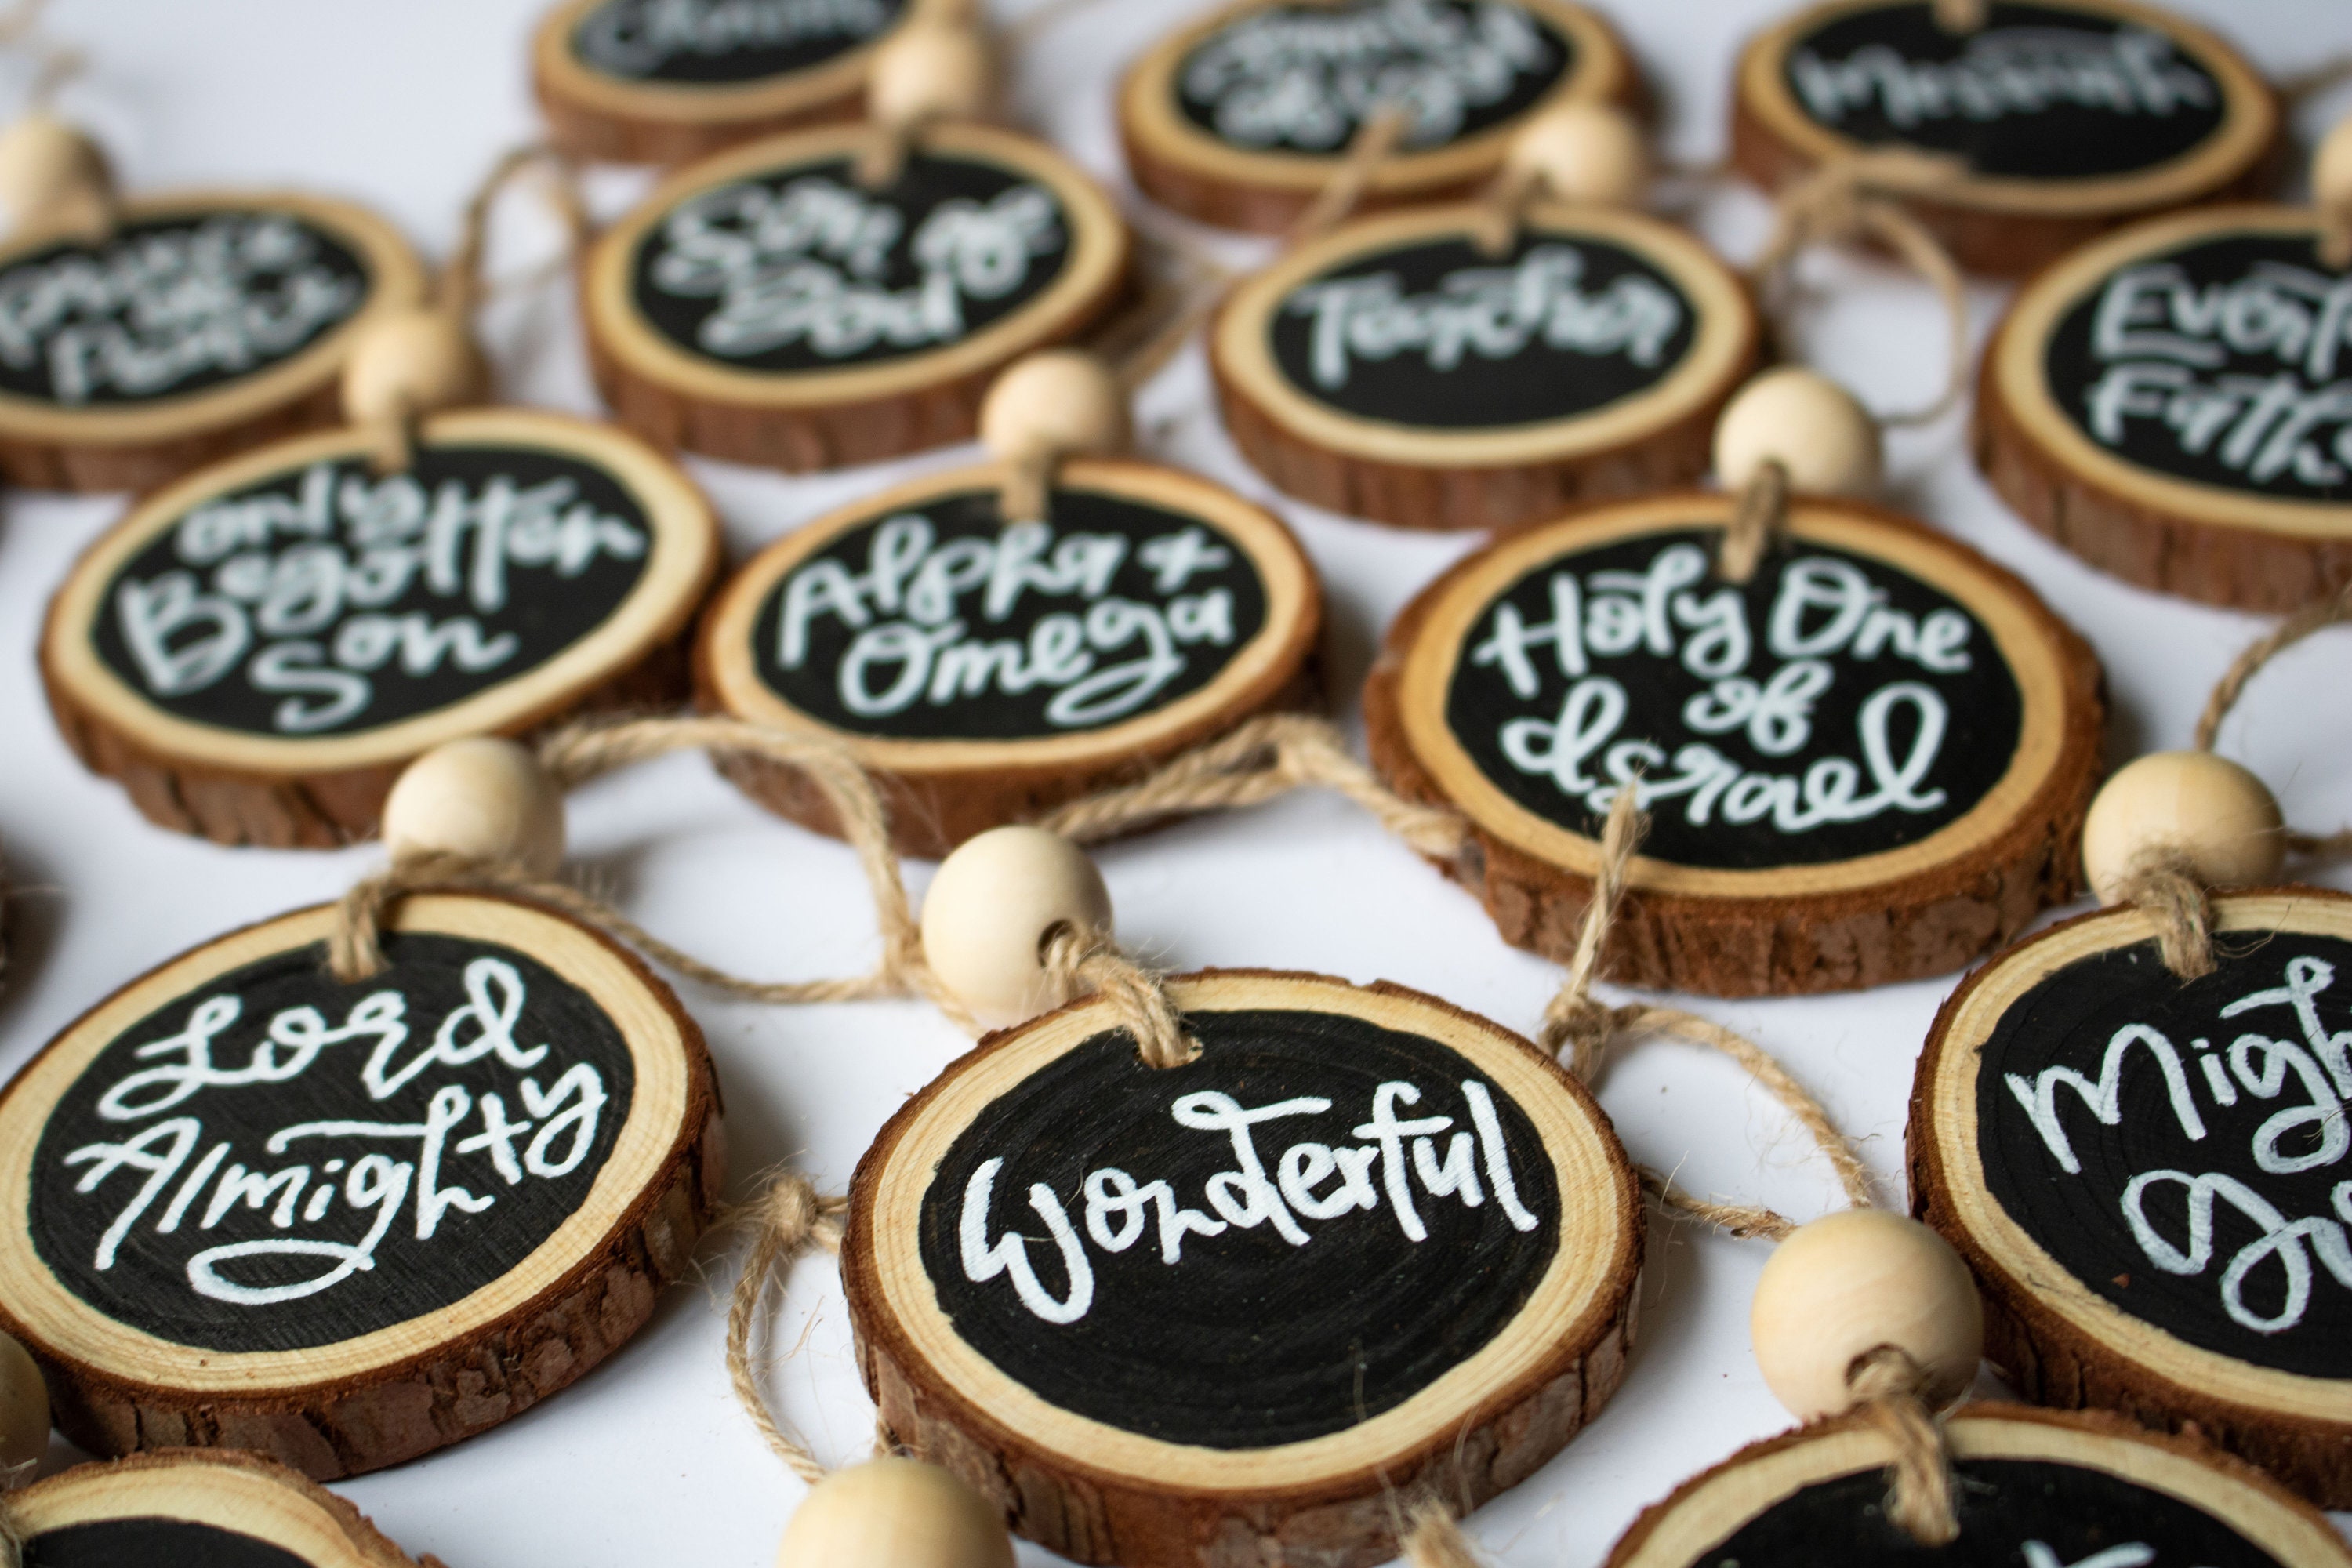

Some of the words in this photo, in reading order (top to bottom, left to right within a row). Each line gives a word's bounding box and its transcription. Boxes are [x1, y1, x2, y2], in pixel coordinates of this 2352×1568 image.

[1286, 245, 1682, 390] Teacher
[776, 514, 1127, 670] Alpha
[837, 588, 1236, 726] Omega
[1472, 544, 1751, 699] Holy
[1766, 557, 1973, 672] One
[249, 610, 521, 732] Son
[1683, 659, 1836, 754] of
[1499, 676, 1947, 834] Israel
[96, 957, 550, 1121] Lord
[2003, 955, 2352, 1174] Migh
[62, 1062, 609, 1305] Almighty
[958, 1078, 1540, 1325] Wonderful
